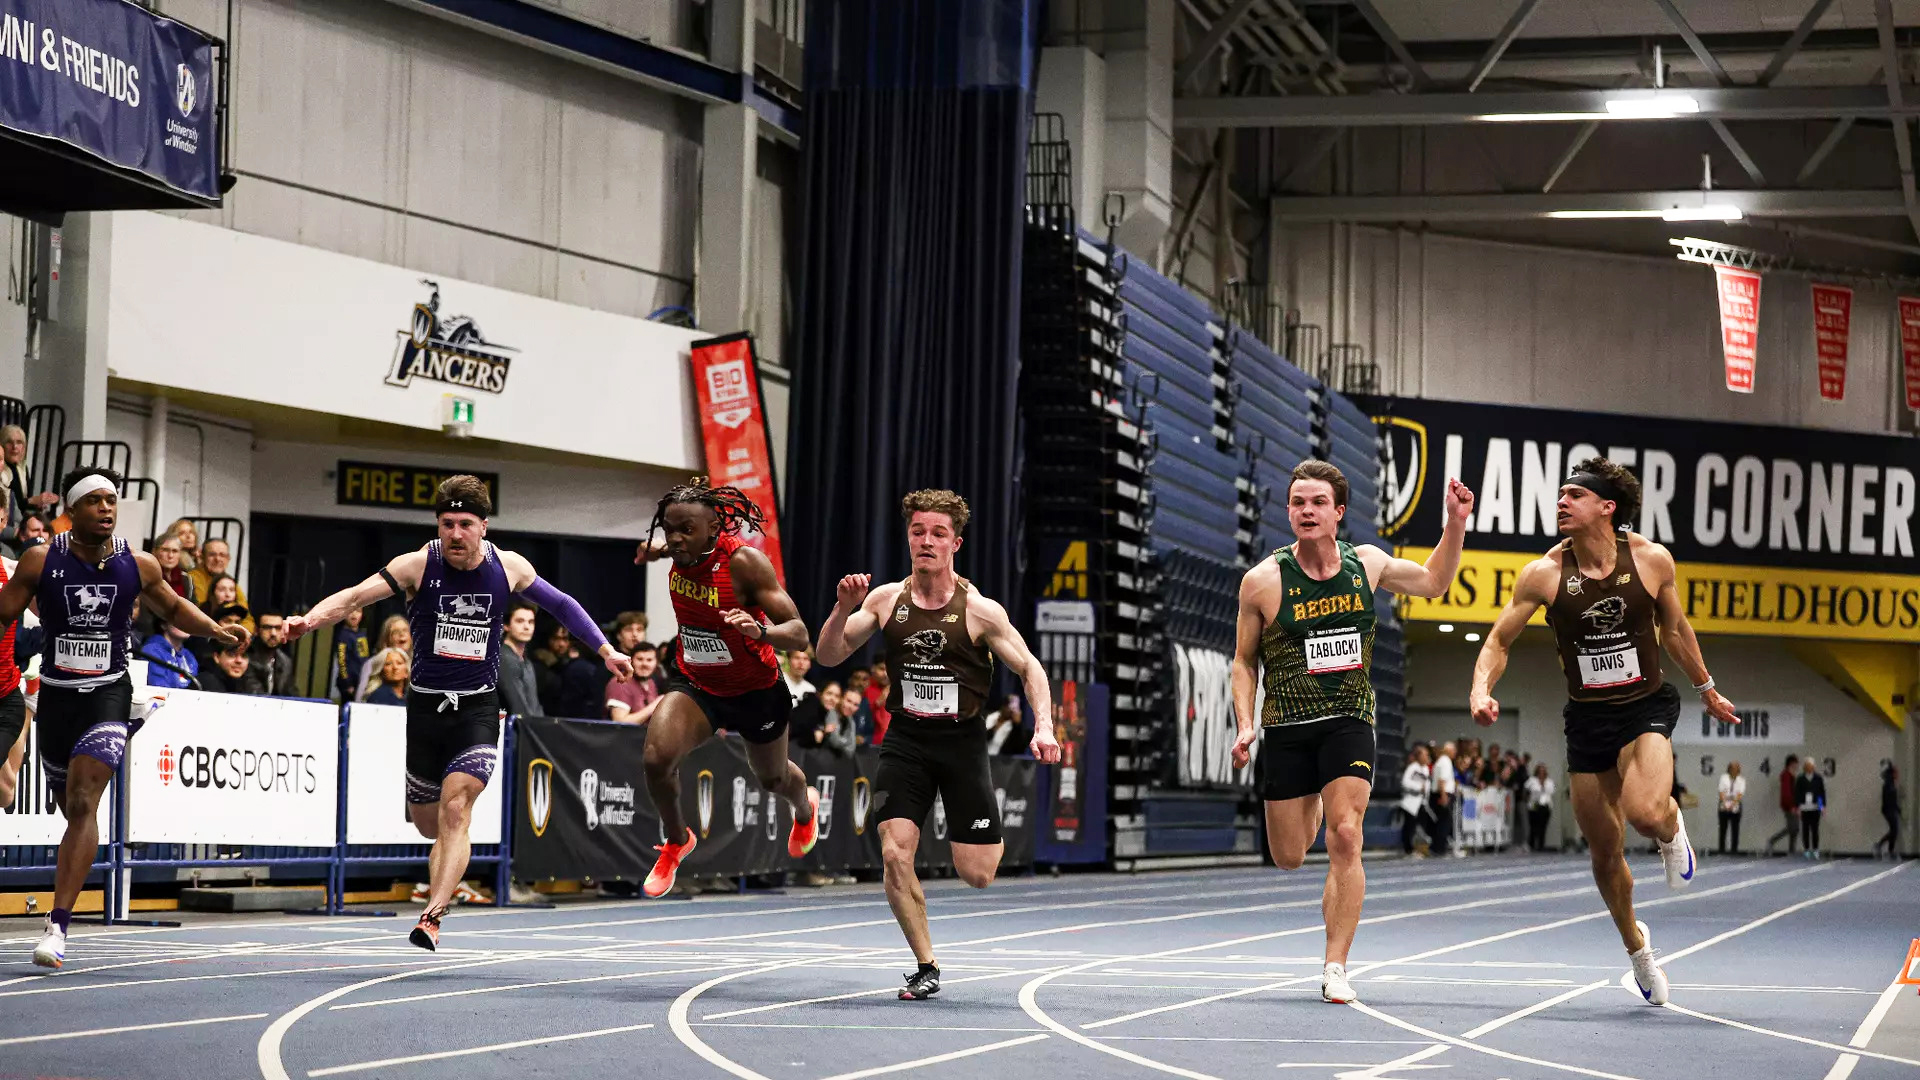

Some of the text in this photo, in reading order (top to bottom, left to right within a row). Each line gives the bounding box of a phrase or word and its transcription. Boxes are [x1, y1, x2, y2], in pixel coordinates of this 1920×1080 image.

[40, 28, 62, 73] &
[61, 35, 140, 108] FRIENDS
[167, 117, 199, 143] University
[172, 134, 198, 155] Windsor
[384, 330, 513, 394] LANCERS
[345, 467, 447, 505] FIRE EX
[1442, 433, 1916, 557] LANR CORNER
[669, 571, 720, 608] GUELPH
[1292, 592, 1365, 622] REGINA
[1685, 576, 1919, 629] FIELDHOUS
[437, 624, 489, 644] THOMPSON
[682, 636, 728, 653] CAMPBELL
[1584, 631, 1627, 640] MANITOBA
[58, 639, 108, 658] ONYEMAH
[1309, 639, 1358, 659] ZABLOCKI
[903, 662, 946, 670] MANITOBA
[1591, 653, 1625, 672] DAVIS
[914, 683, 944, 700] SOUFI
[1717, 710, 1770, 738] SORTS
[1759, 757, 1770, 777] 4
